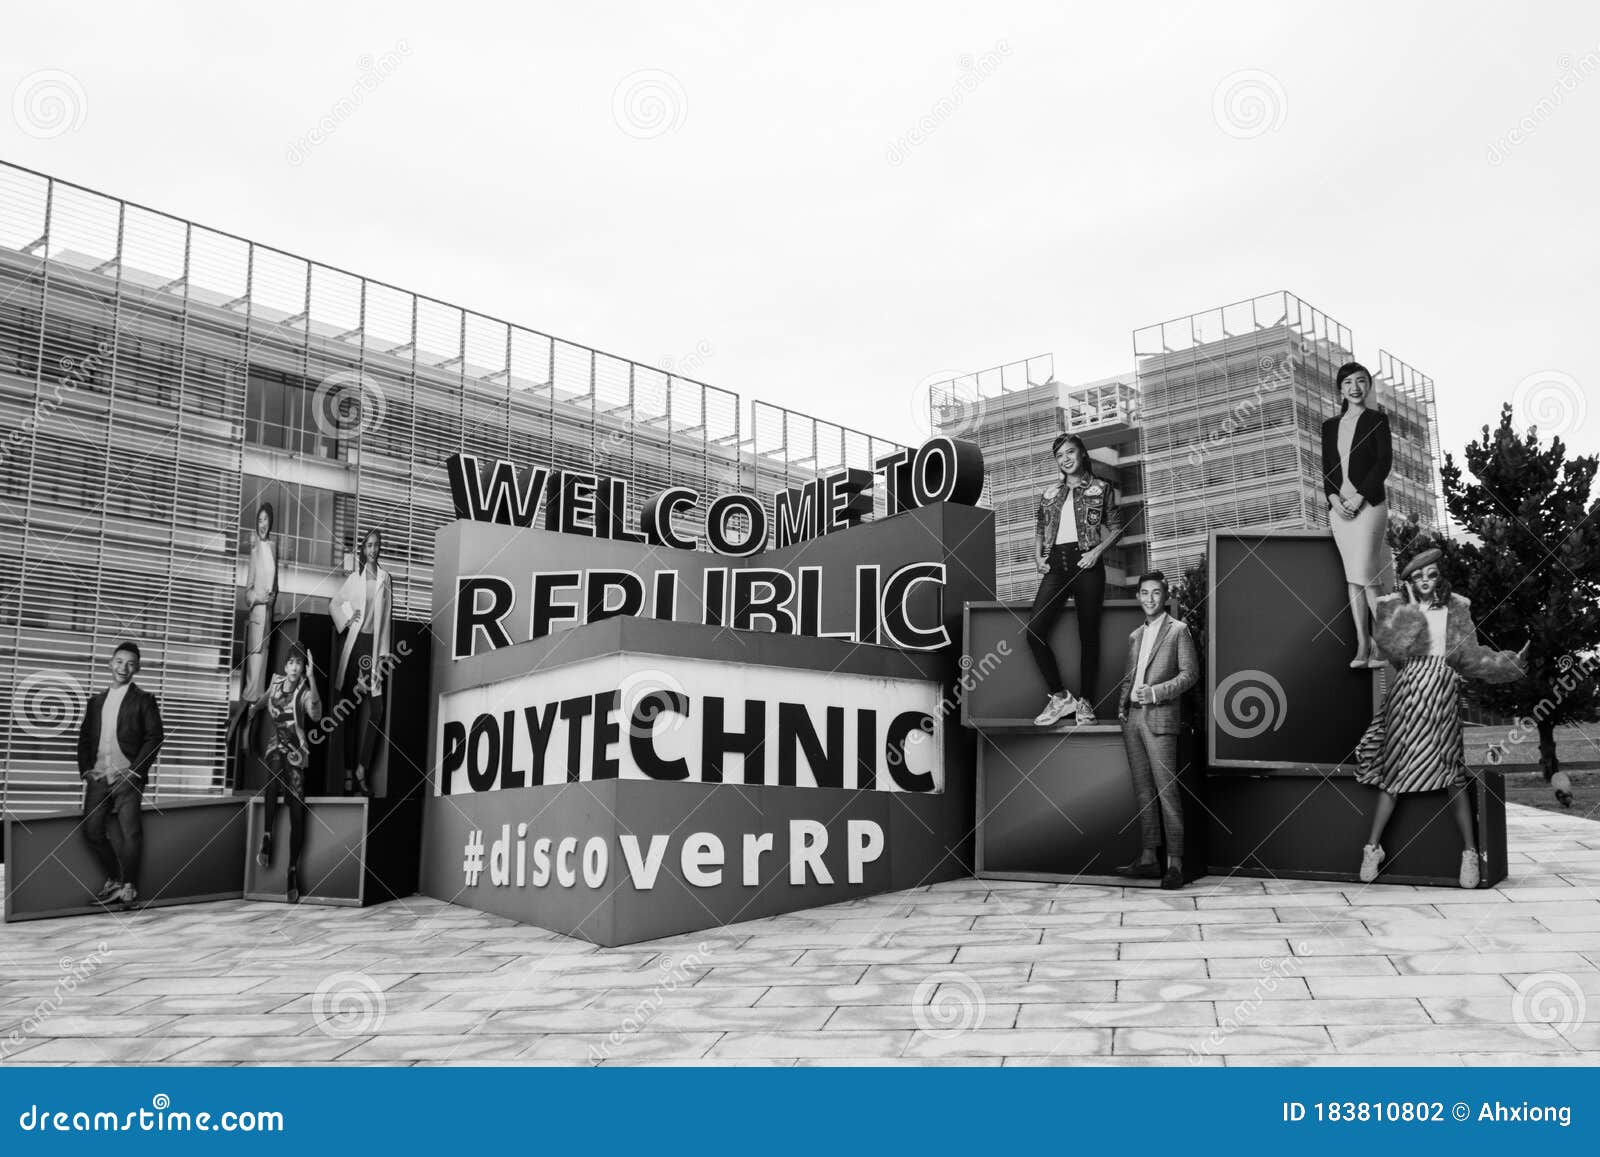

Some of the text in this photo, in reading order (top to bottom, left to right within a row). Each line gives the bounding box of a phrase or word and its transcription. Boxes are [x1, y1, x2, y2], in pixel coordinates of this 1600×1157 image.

[456, 436, 962, 557] WELCOME TO
[451, 562, 952, 661] REPUBLIC
[441, 689, 937, 796] POLYTECHNIC
[463, 819, 886, 890] #discoverRP
